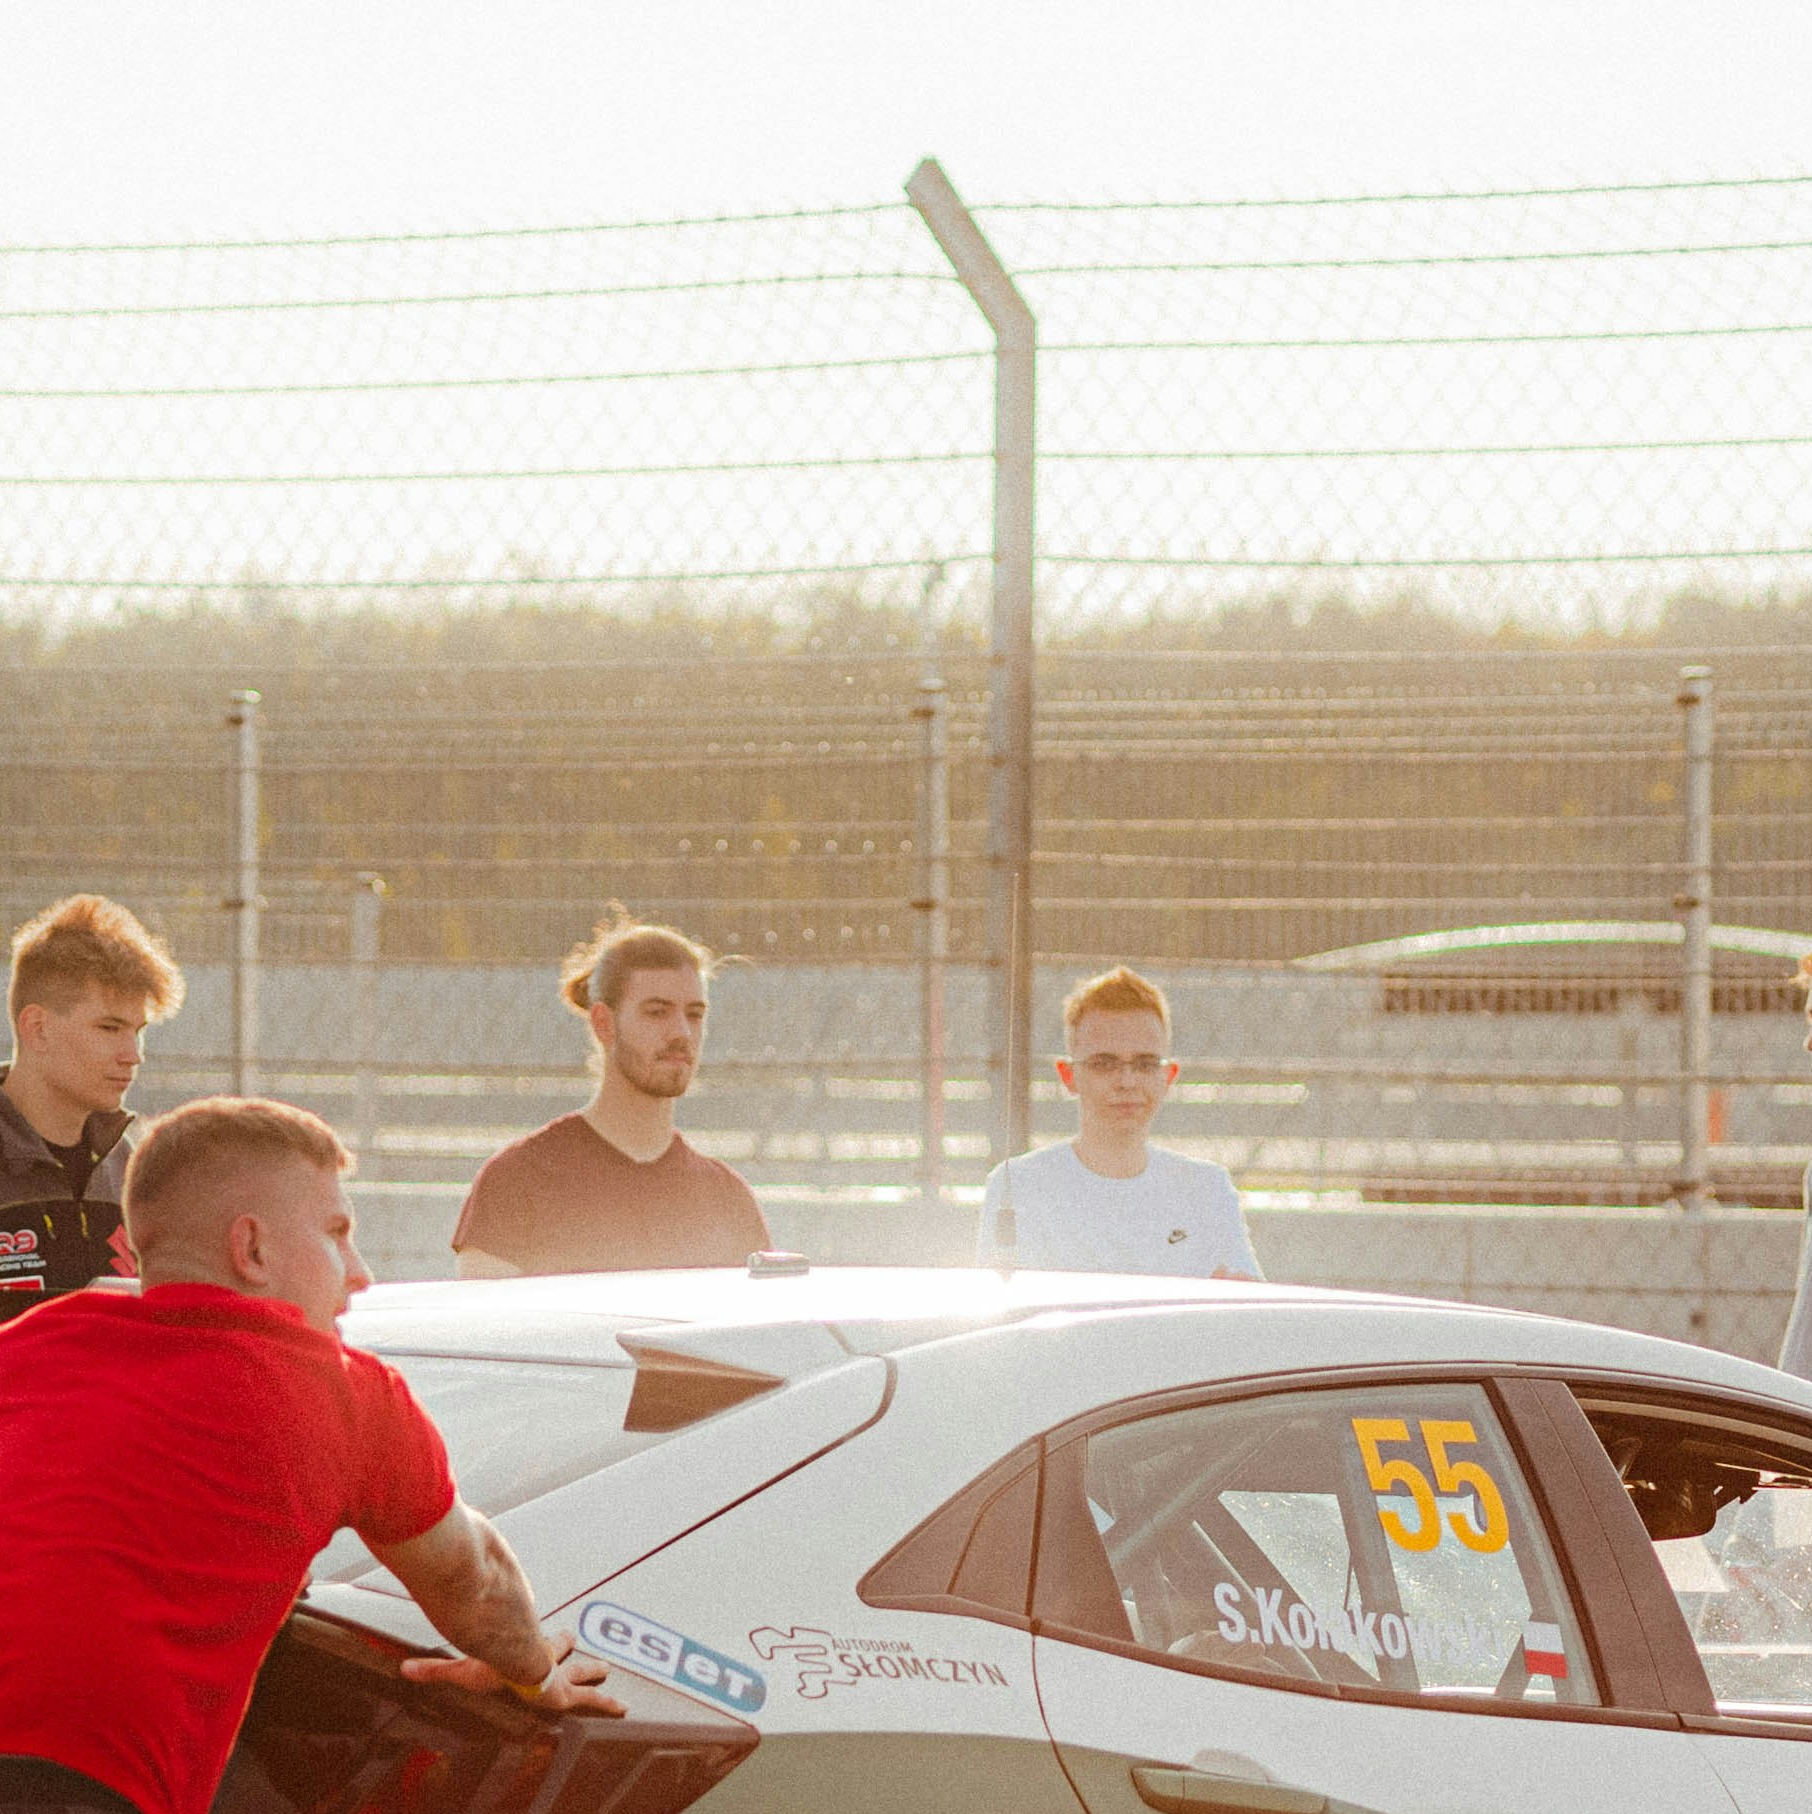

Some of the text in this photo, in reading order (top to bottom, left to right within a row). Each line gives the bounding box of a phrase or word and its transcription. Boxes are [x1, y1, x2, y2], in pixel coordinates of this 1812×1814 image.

[1352, 1418, 1509, 1553] 55
[832, 1639, 914, 1652] AUTODROM
[839, 1654, 1010, 1687] SŁOMCZYN
